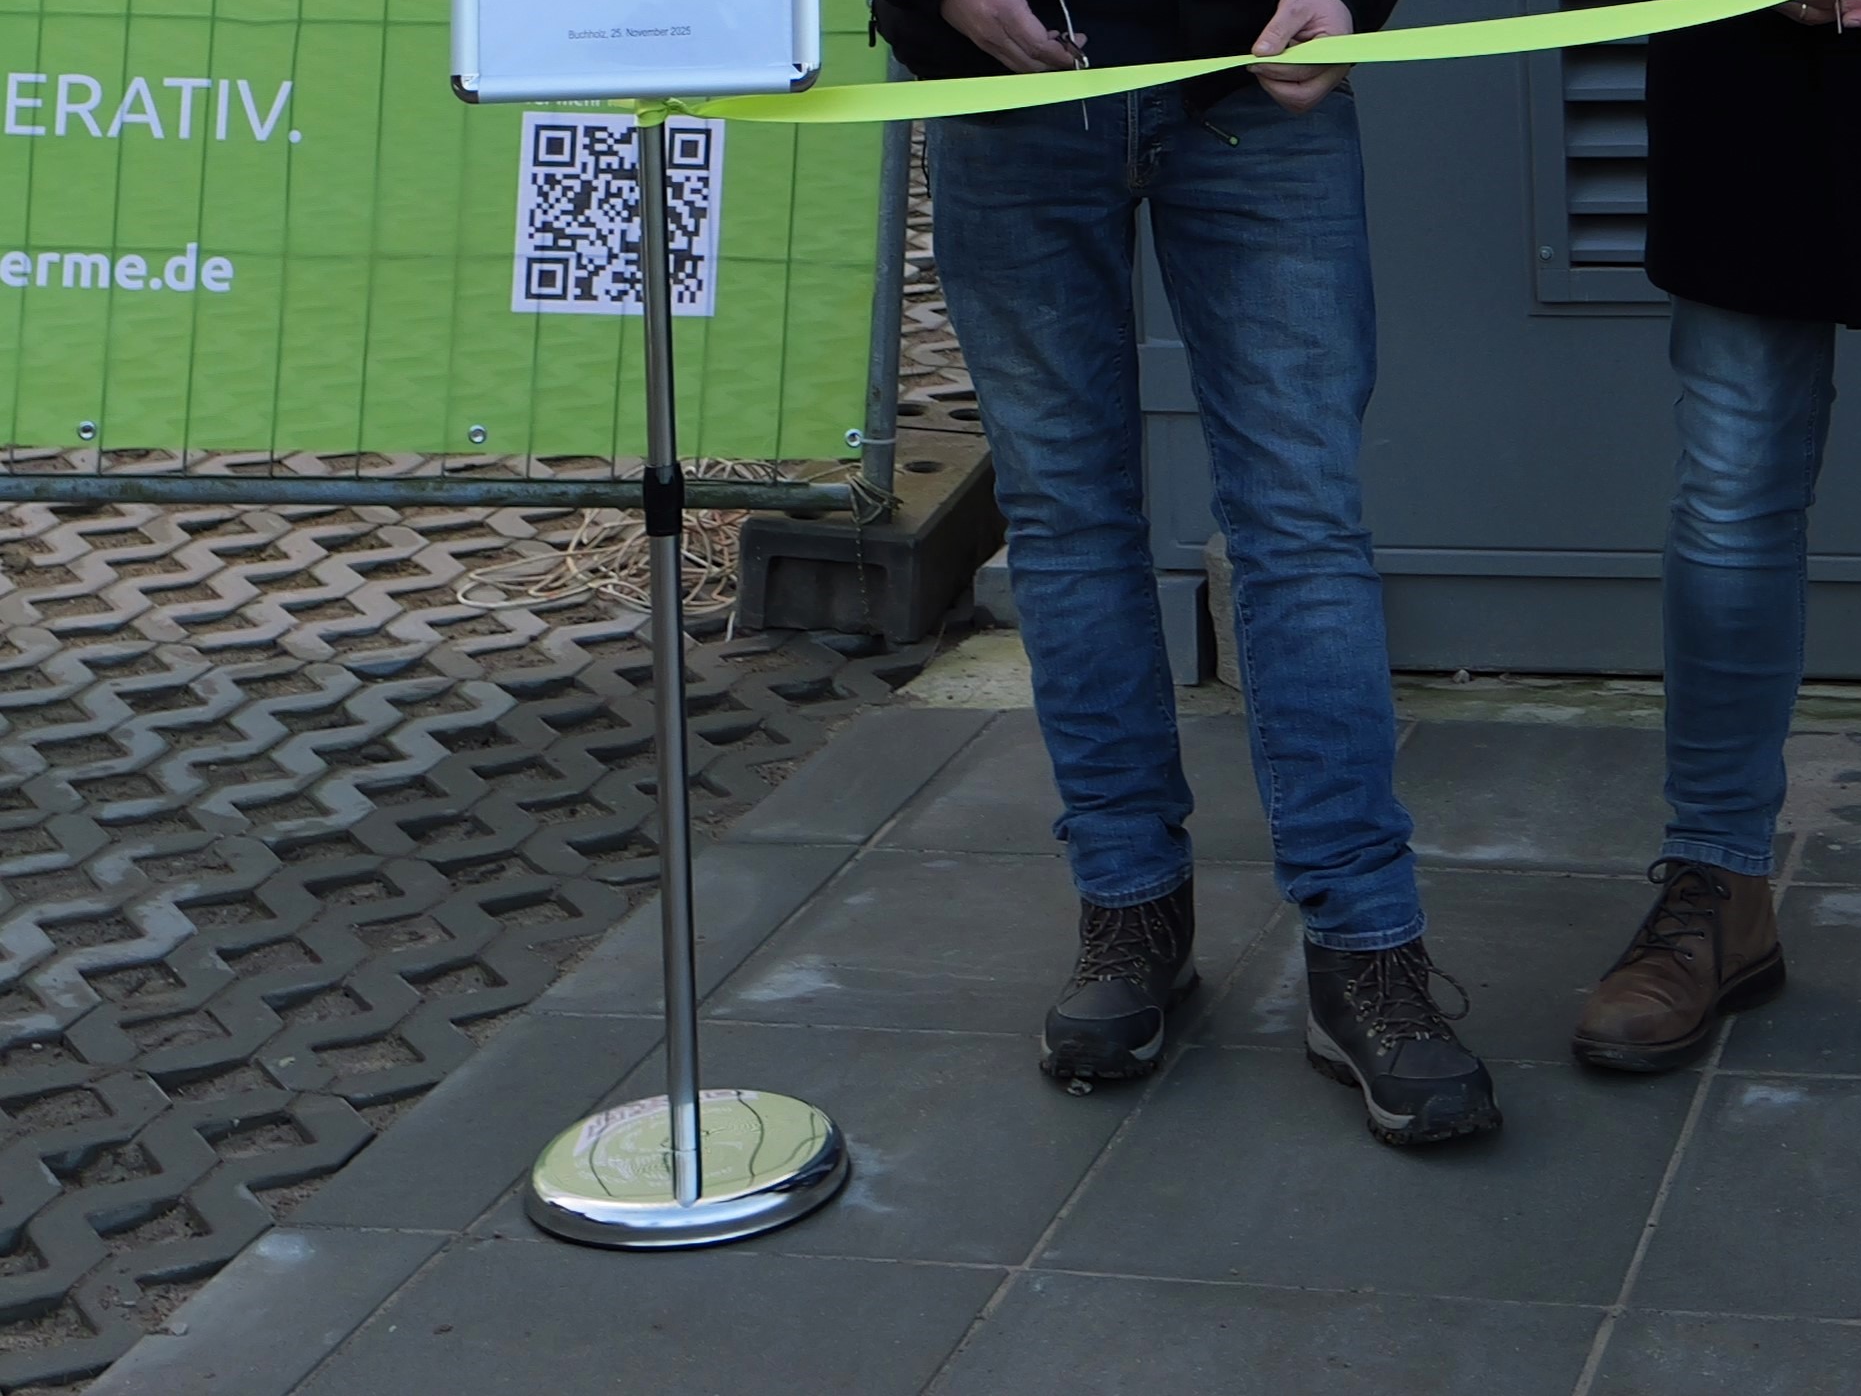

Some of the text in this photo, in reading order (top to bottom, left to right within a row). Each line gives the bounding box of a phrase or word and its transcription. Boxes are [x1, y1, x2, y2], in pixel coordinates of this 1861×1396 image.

[626, 26, 669, 38] November
[670, 25, 691, 37] 2025
[4, 71, 302, 144] ERATIV.
[0, 241, 235, 293] erme.de
